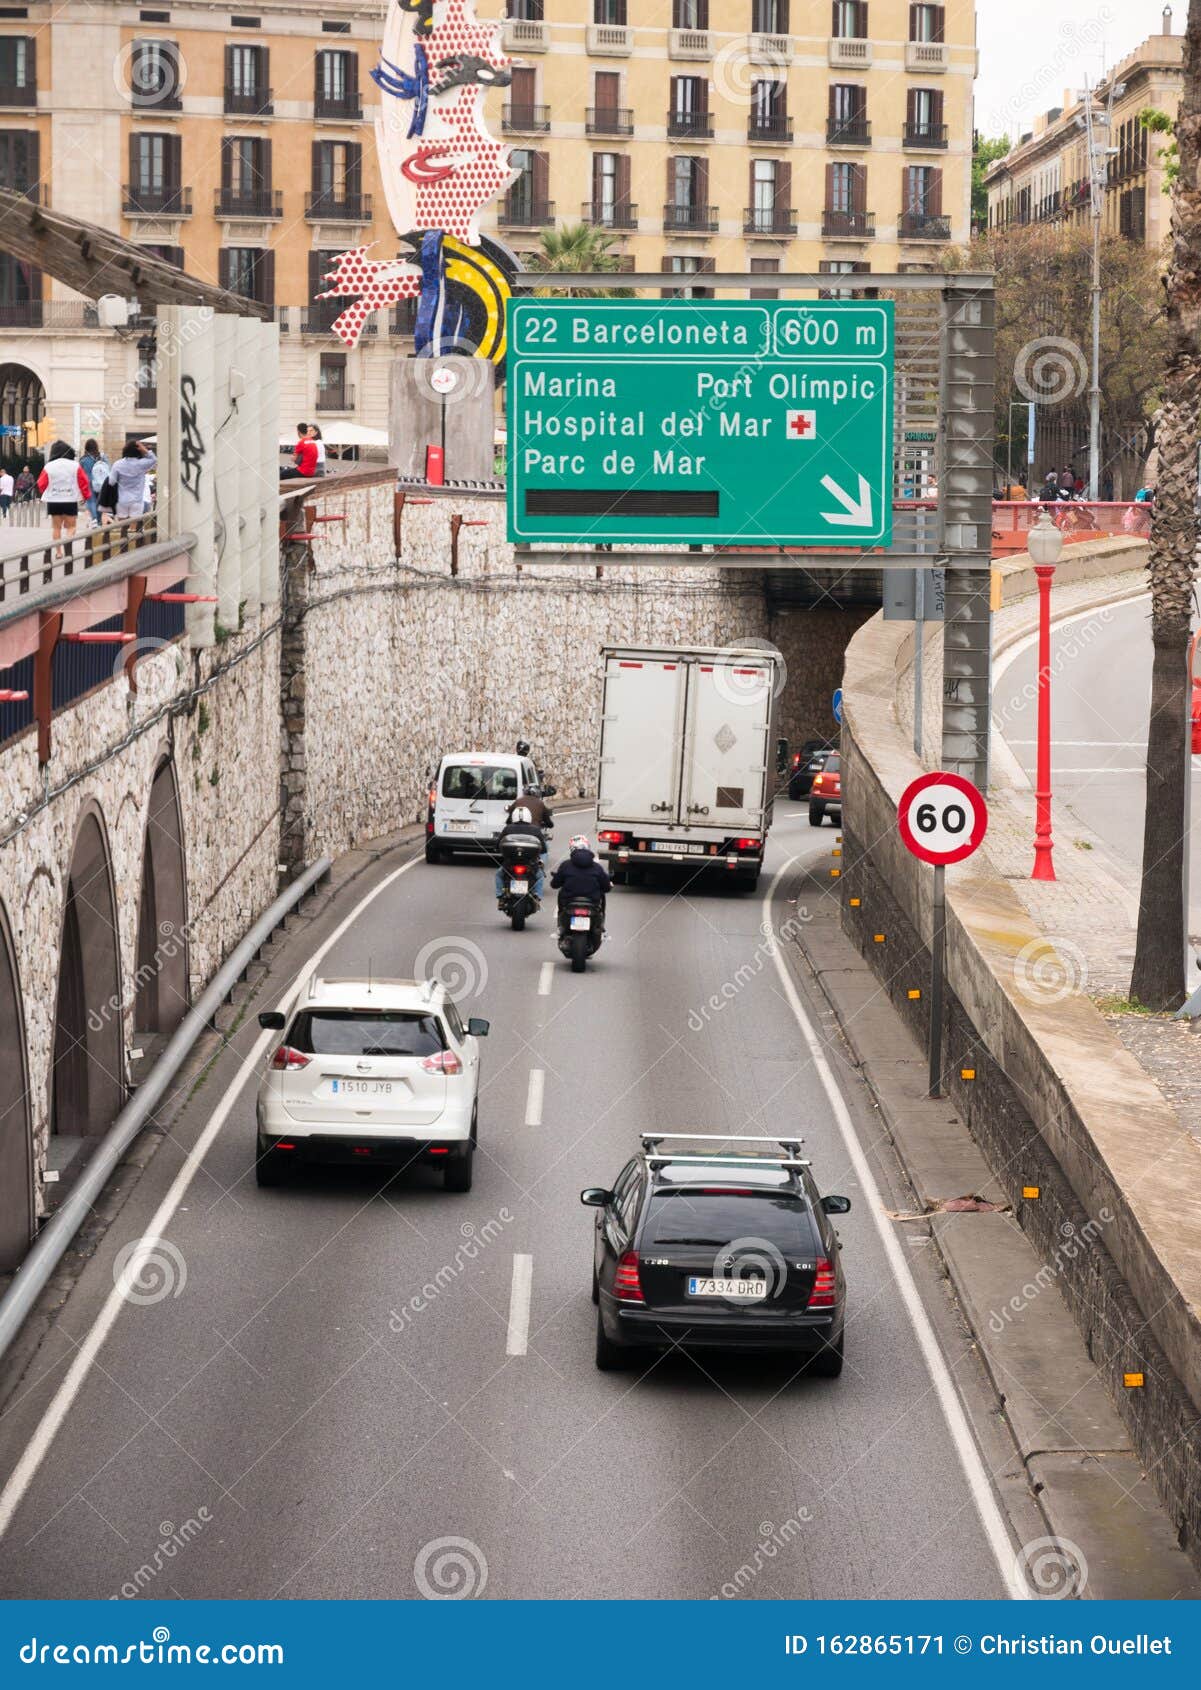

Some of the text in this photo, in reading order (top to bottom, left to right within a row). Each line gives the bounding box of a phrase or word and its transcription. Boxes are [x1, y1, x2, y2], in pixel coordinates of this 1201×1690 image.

[525, 318, 876, 346] 22 Barceloneta 600 m
[524, 372, 875, 405] Marina Port Olímpic
[525, 410, 772, 441] Hospital del Mar
[524, 449, 706, 476] Parc de Mar
[917, 804, 966, 833] 60
[342, 1082, 392, 1093] 1510 JYB
[699, 1280, 763, 1295] 7334 DRD
